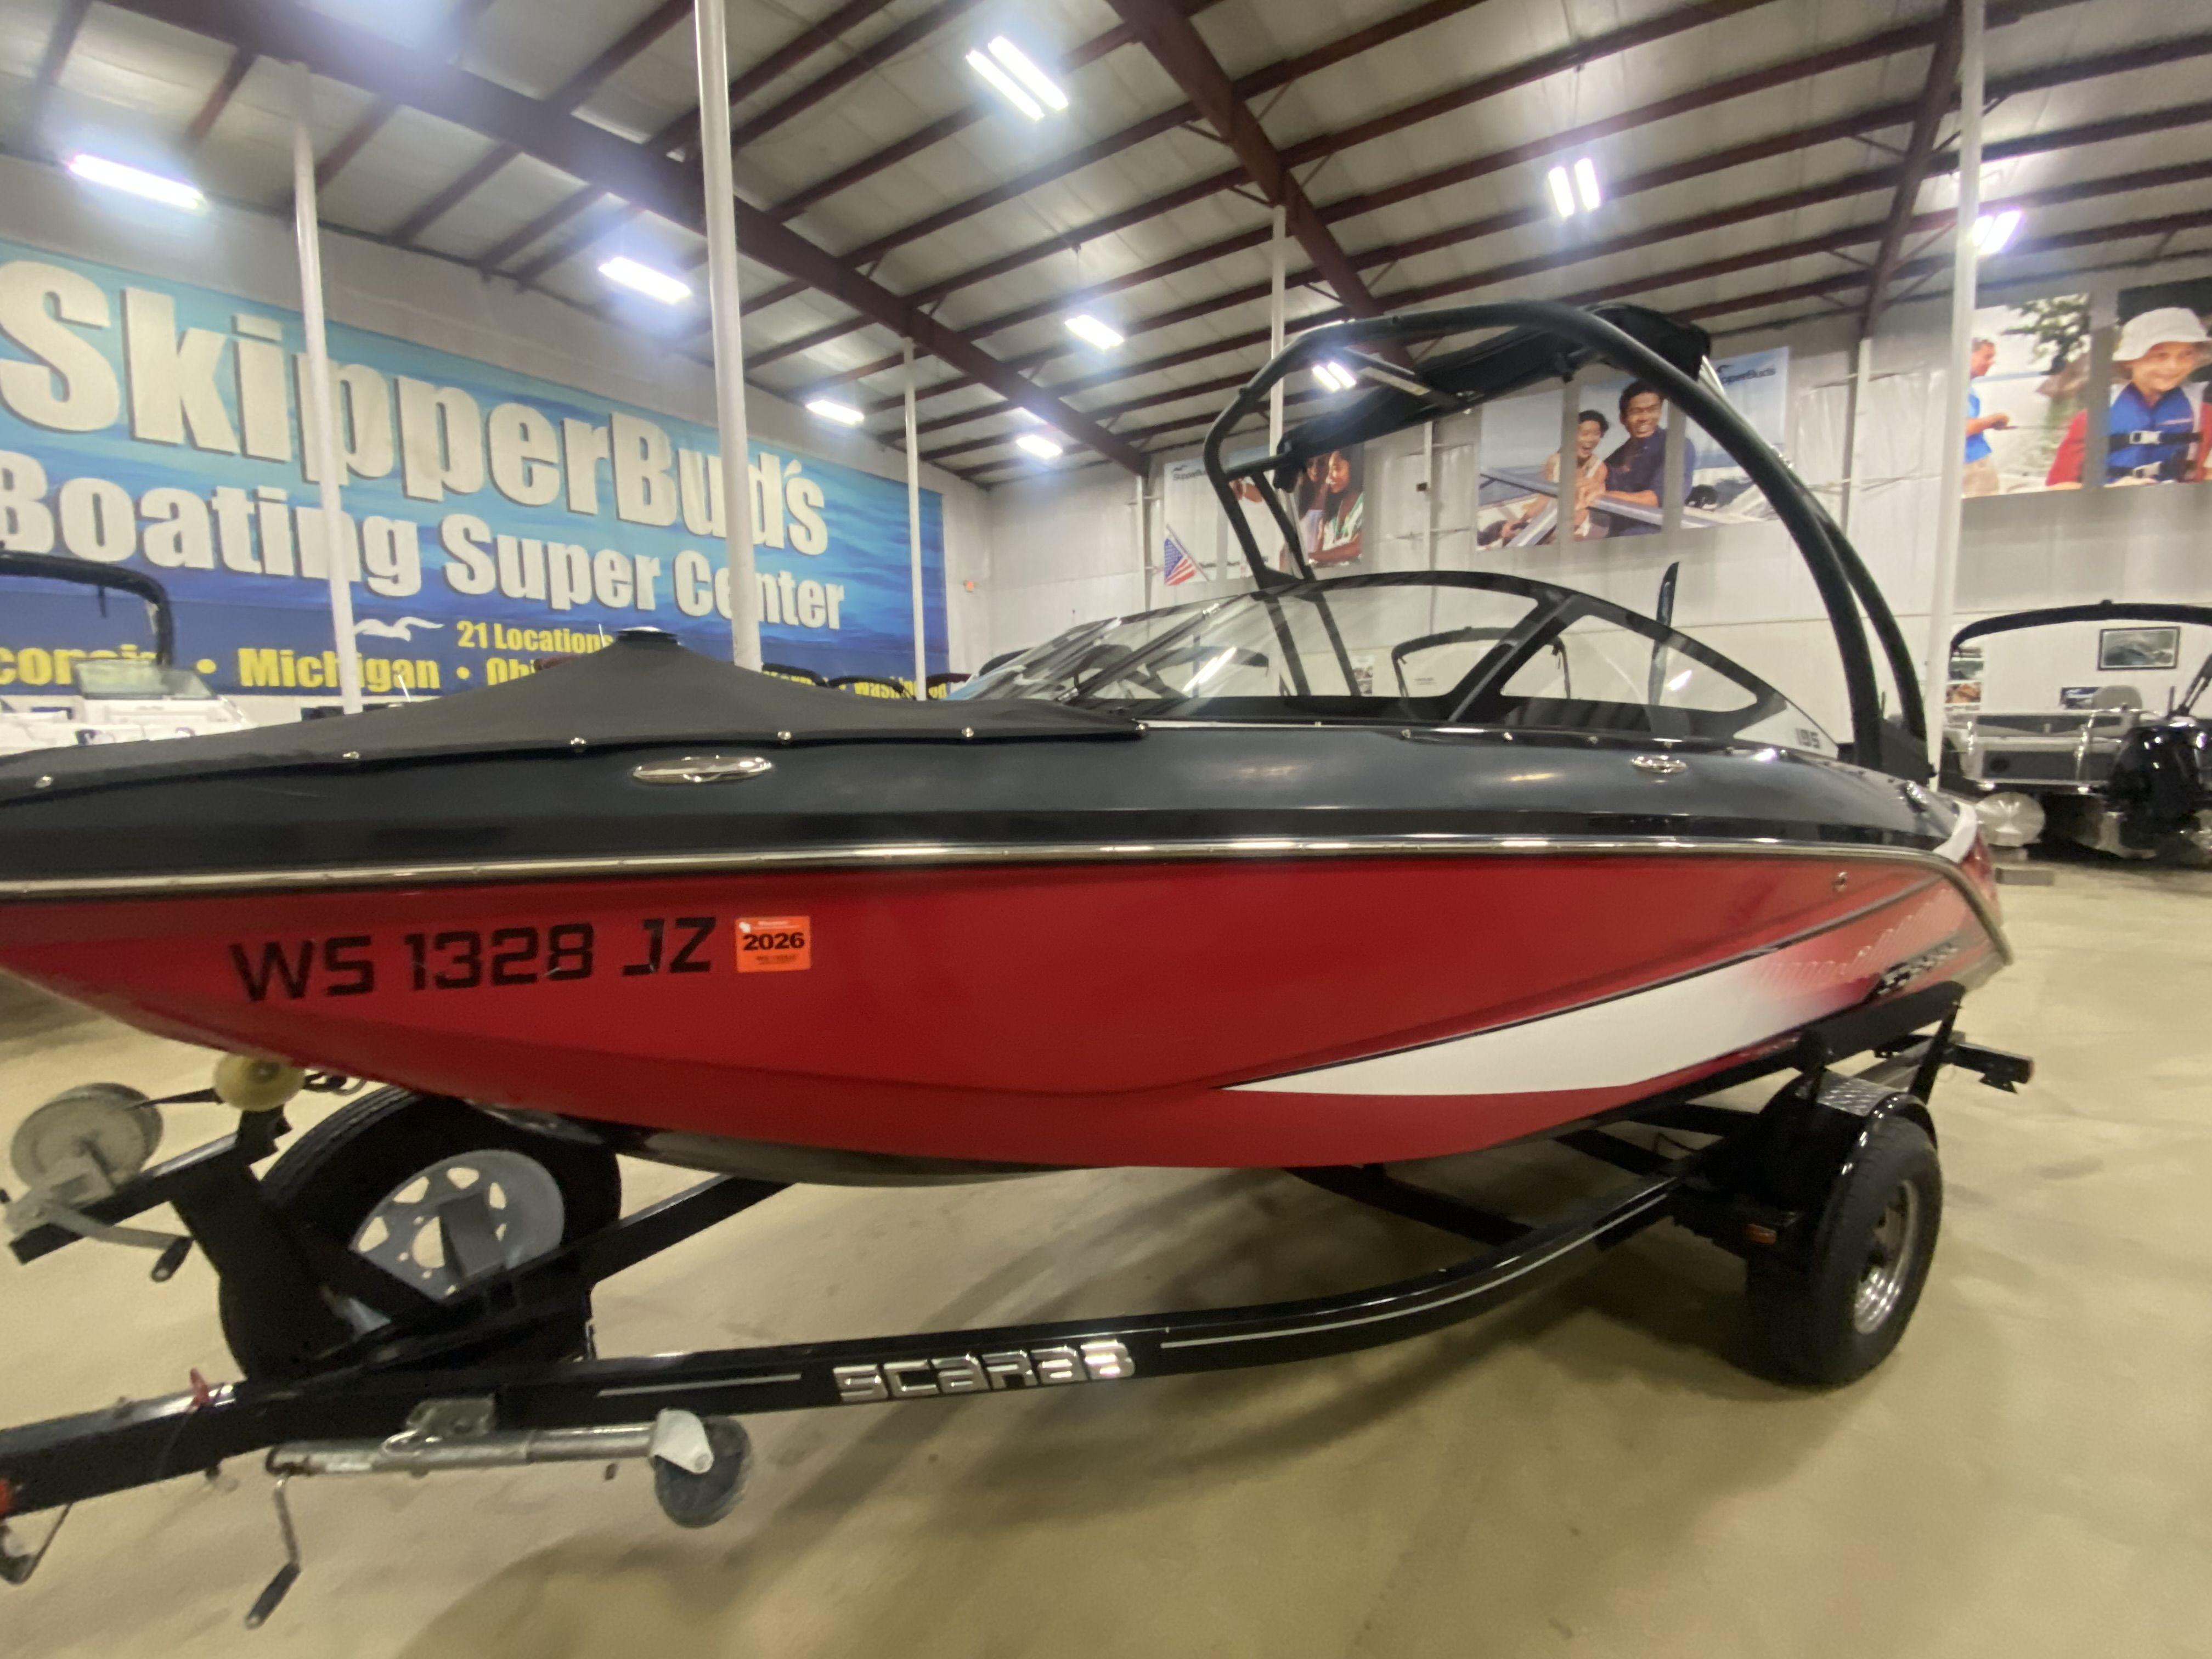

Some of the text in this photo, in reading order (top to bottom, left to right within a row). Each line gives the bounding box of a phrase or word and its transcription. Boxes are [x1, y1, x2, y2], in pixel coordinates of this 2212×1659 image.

[0, 450, 845, 630] Boating Super Center
[456, 620, 614, 654] 21 Locations
[229, 916, 717, 1002] WS 1328 JZ
[743, 932, 805, 951] 2026
